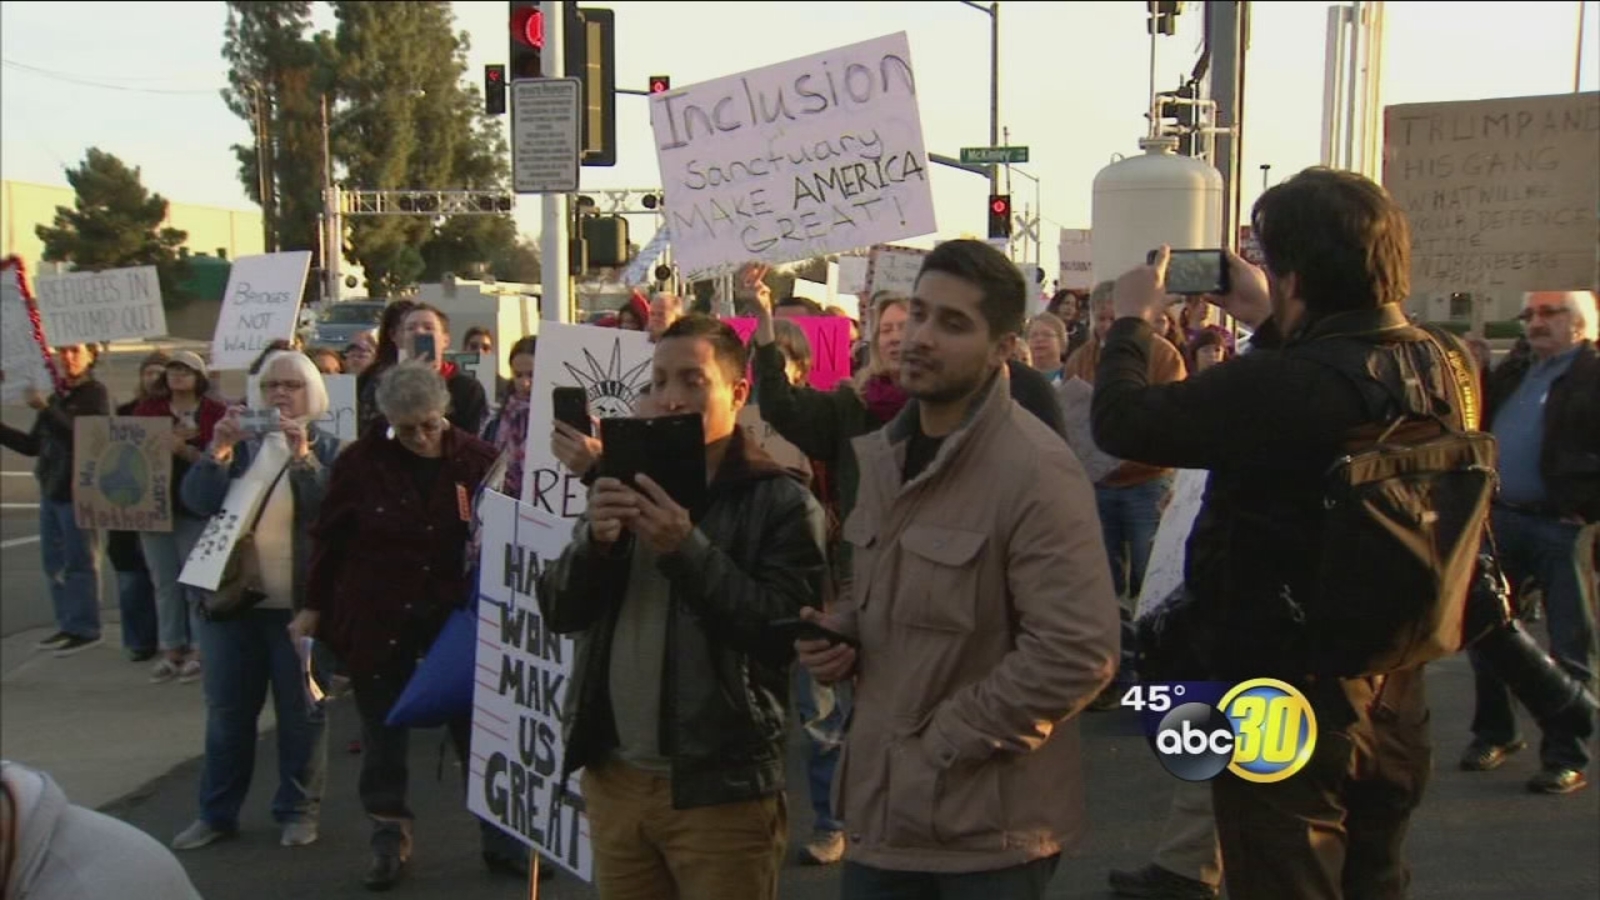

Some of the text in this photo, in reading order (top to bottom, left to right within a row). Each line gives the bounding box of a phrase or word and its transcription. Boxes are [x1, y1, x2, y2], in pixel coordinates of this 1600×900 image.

[656, 54, 916, 151] Inclusion
[1399, 110, 1533, 146] TRUMP
[684, 130, 884, 190] Sanctuary
[1404, 146, 1560, 180] HIS GANG
[672, 151, 924, 239] MAKE AMERICA
[127, 270, 150, 301] IN
[49, 303, 156, 340] TRUMP OUT
[239, 312, 276, 330] NOT
[518, 715, 556, 776] US
[484, 751, 587, 871] GREAT
